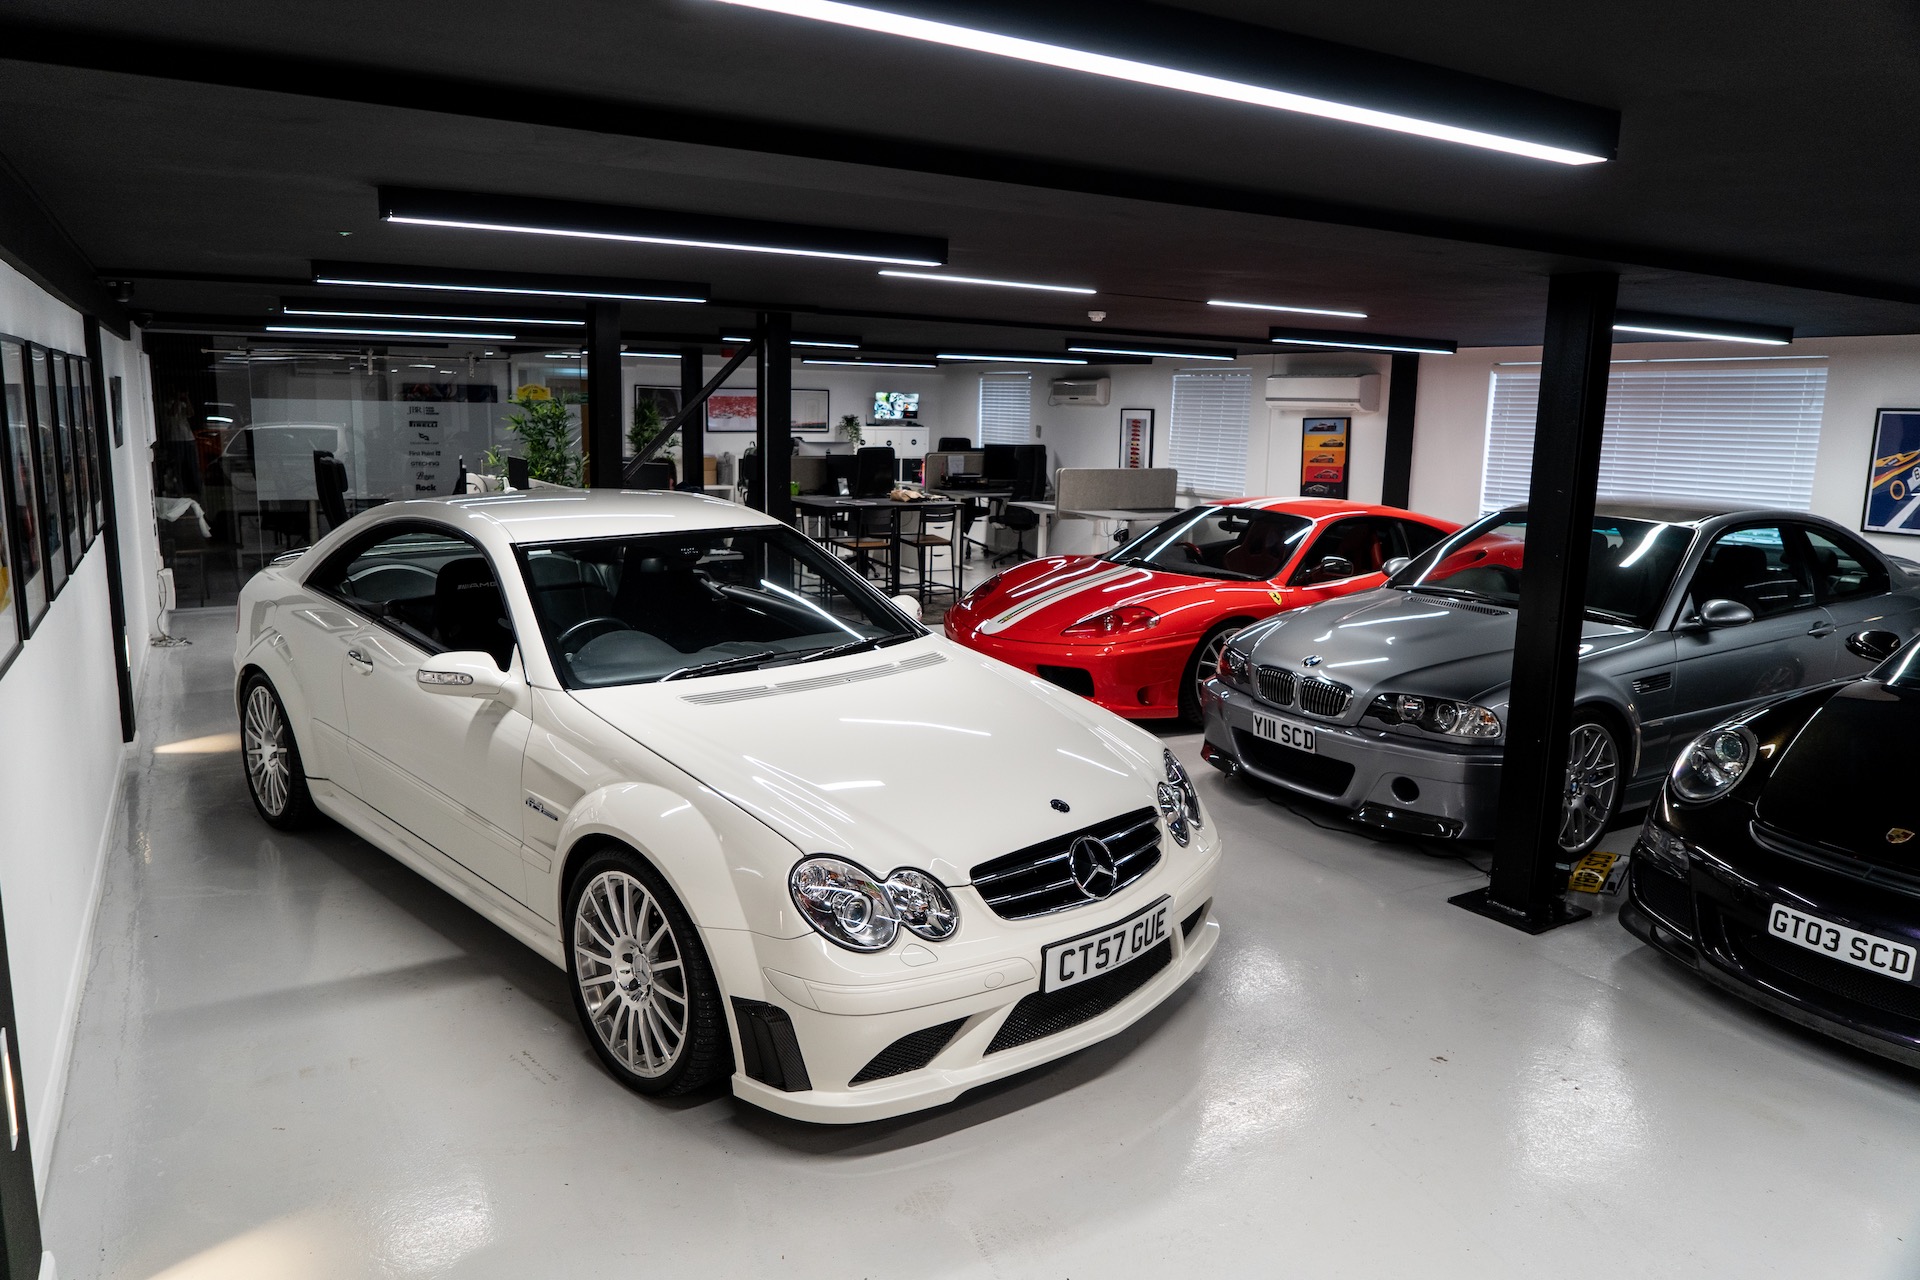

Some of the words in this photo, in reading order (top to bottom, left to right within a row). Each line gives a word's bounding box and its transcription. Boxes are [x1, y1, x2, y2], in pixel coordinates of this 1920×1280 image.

[1281, 724, 1314, 750] SCD
[1059, 930, 1127, 982] CT57
[1131, 907, 1167, 954] GUE
[1773, 910, 1841, 952] GT03
[1849, 937, 1911, 975] SCD
